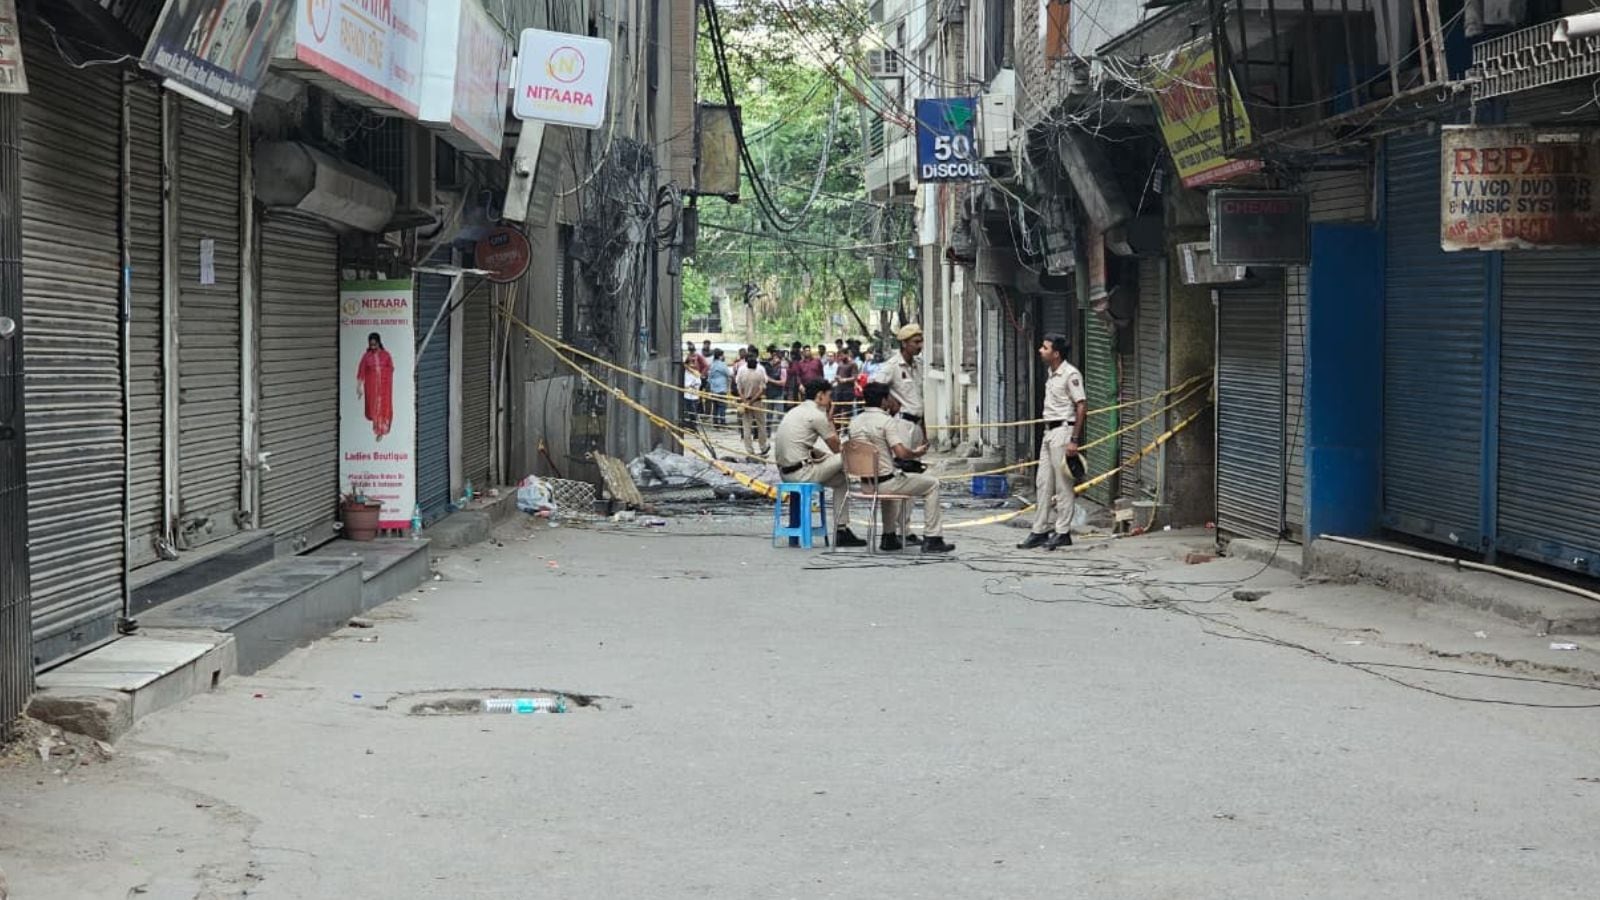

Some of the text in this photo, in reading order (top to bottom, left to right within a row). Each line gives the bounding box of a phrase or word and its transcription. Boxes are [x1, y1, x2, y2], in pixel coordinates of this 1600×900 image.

[526, 85, 594, 107] NITAARA
[1452, 147, 1590, 175] REPAIR
[1480, 179, 1511, 196] VCD
[1461, 199, 1511, 214] MUSIC
[361, 298, 408, 308] NITAARA
[345, 452, 408, 461] Ladies Boutique
